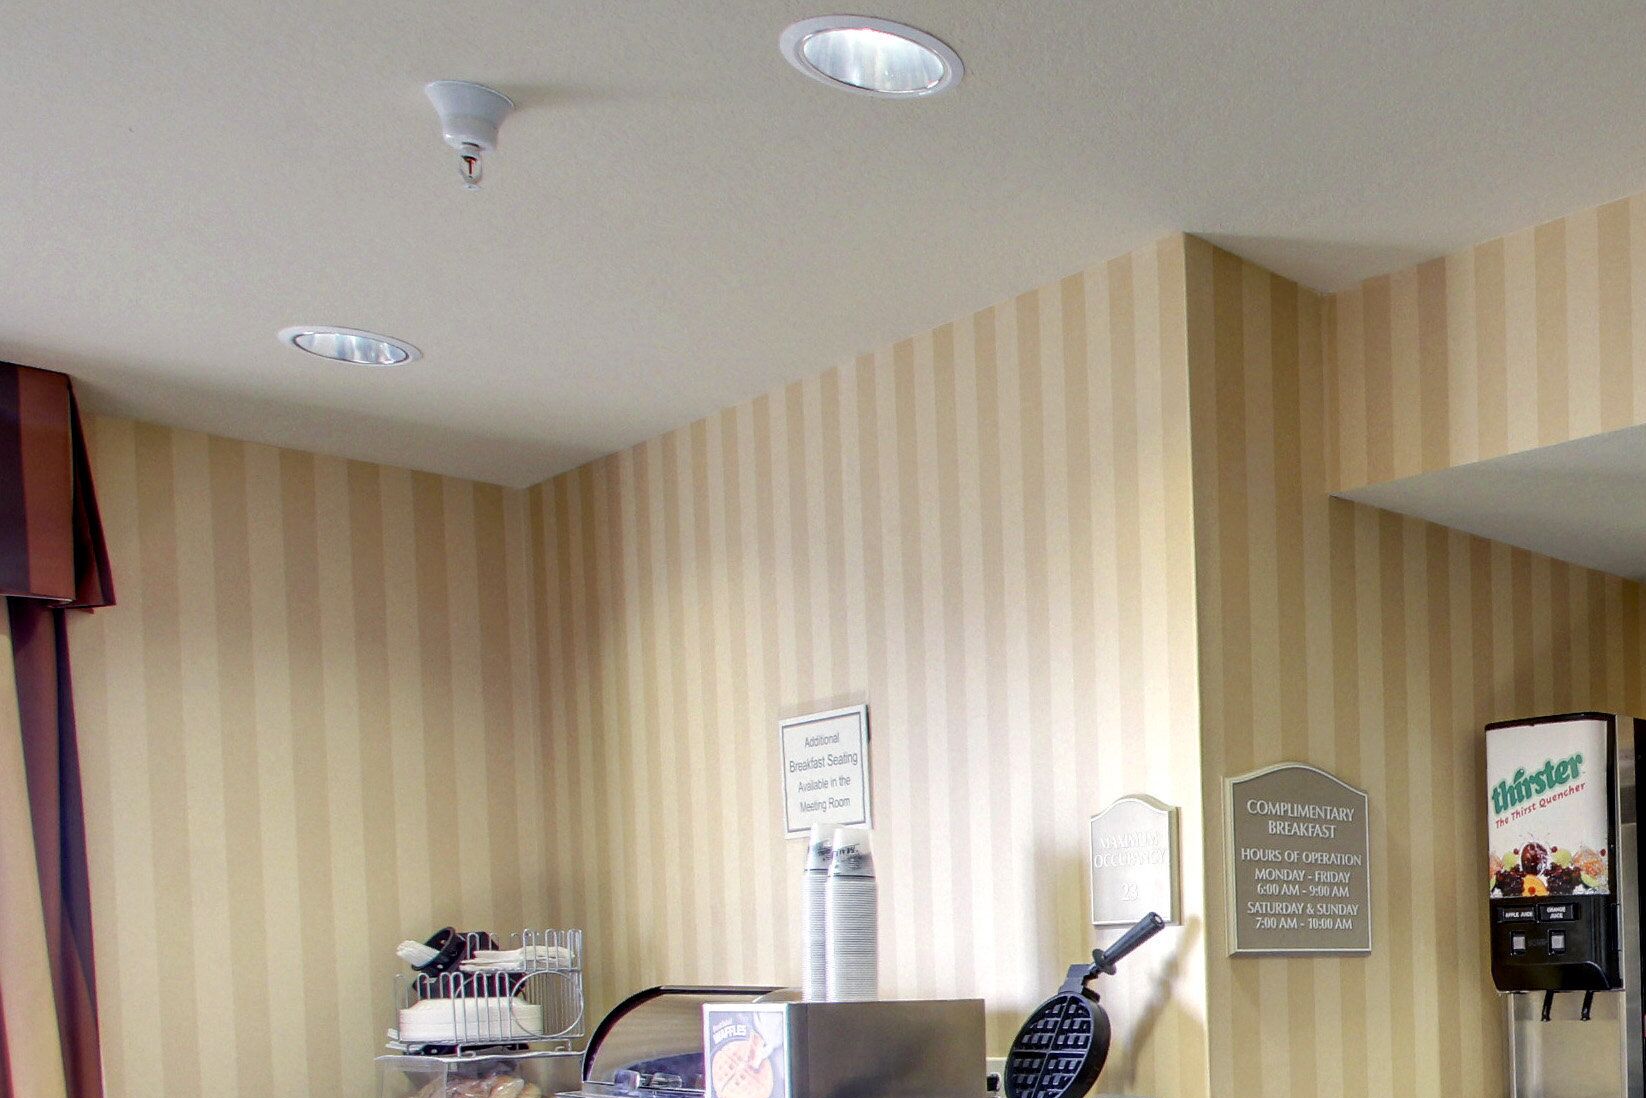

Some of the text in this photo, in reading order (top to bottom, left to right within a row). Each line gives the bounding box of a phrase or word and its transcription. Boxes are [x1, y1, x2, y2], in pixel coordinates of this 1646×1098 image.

[804, 733, 840, 748] Additional
[789, 752, 858, 773] Breakfast Seating
[798, 775, 851, 793] Available in the
[1491, 751, 1584, 815] thirster
[800, 797, 851, 813] Meeting Room
[1246, 800, 1355, 822] COMPLIMENTARY
[1495, 781, 1586, 829] The Thirst Quencher
[1268, 820, 1336, 839] BREAKFAST
[1241, 848, 1362, 866] HOURS OF OPERATION
[1254, 868, 1305, 881] MONDAY
[1315, 871, 1350, 883] FRIDAY
[1257, 883, 1279, 896] 6:00
[1281, 884, 1300, 896] AM
[1309, 885, 1330, 897] 9:00
[1331, 885, 1350, 898] AM
[1247, 901, 1359, 916] SATURDAY & SUNDAY
[1255, 917, 1277, 929] 7:00
[1279, 917, 1298, 929] AM
[1308, 917, 1333, 930] 10:00
[1334, 917, 1353, 930] AM
